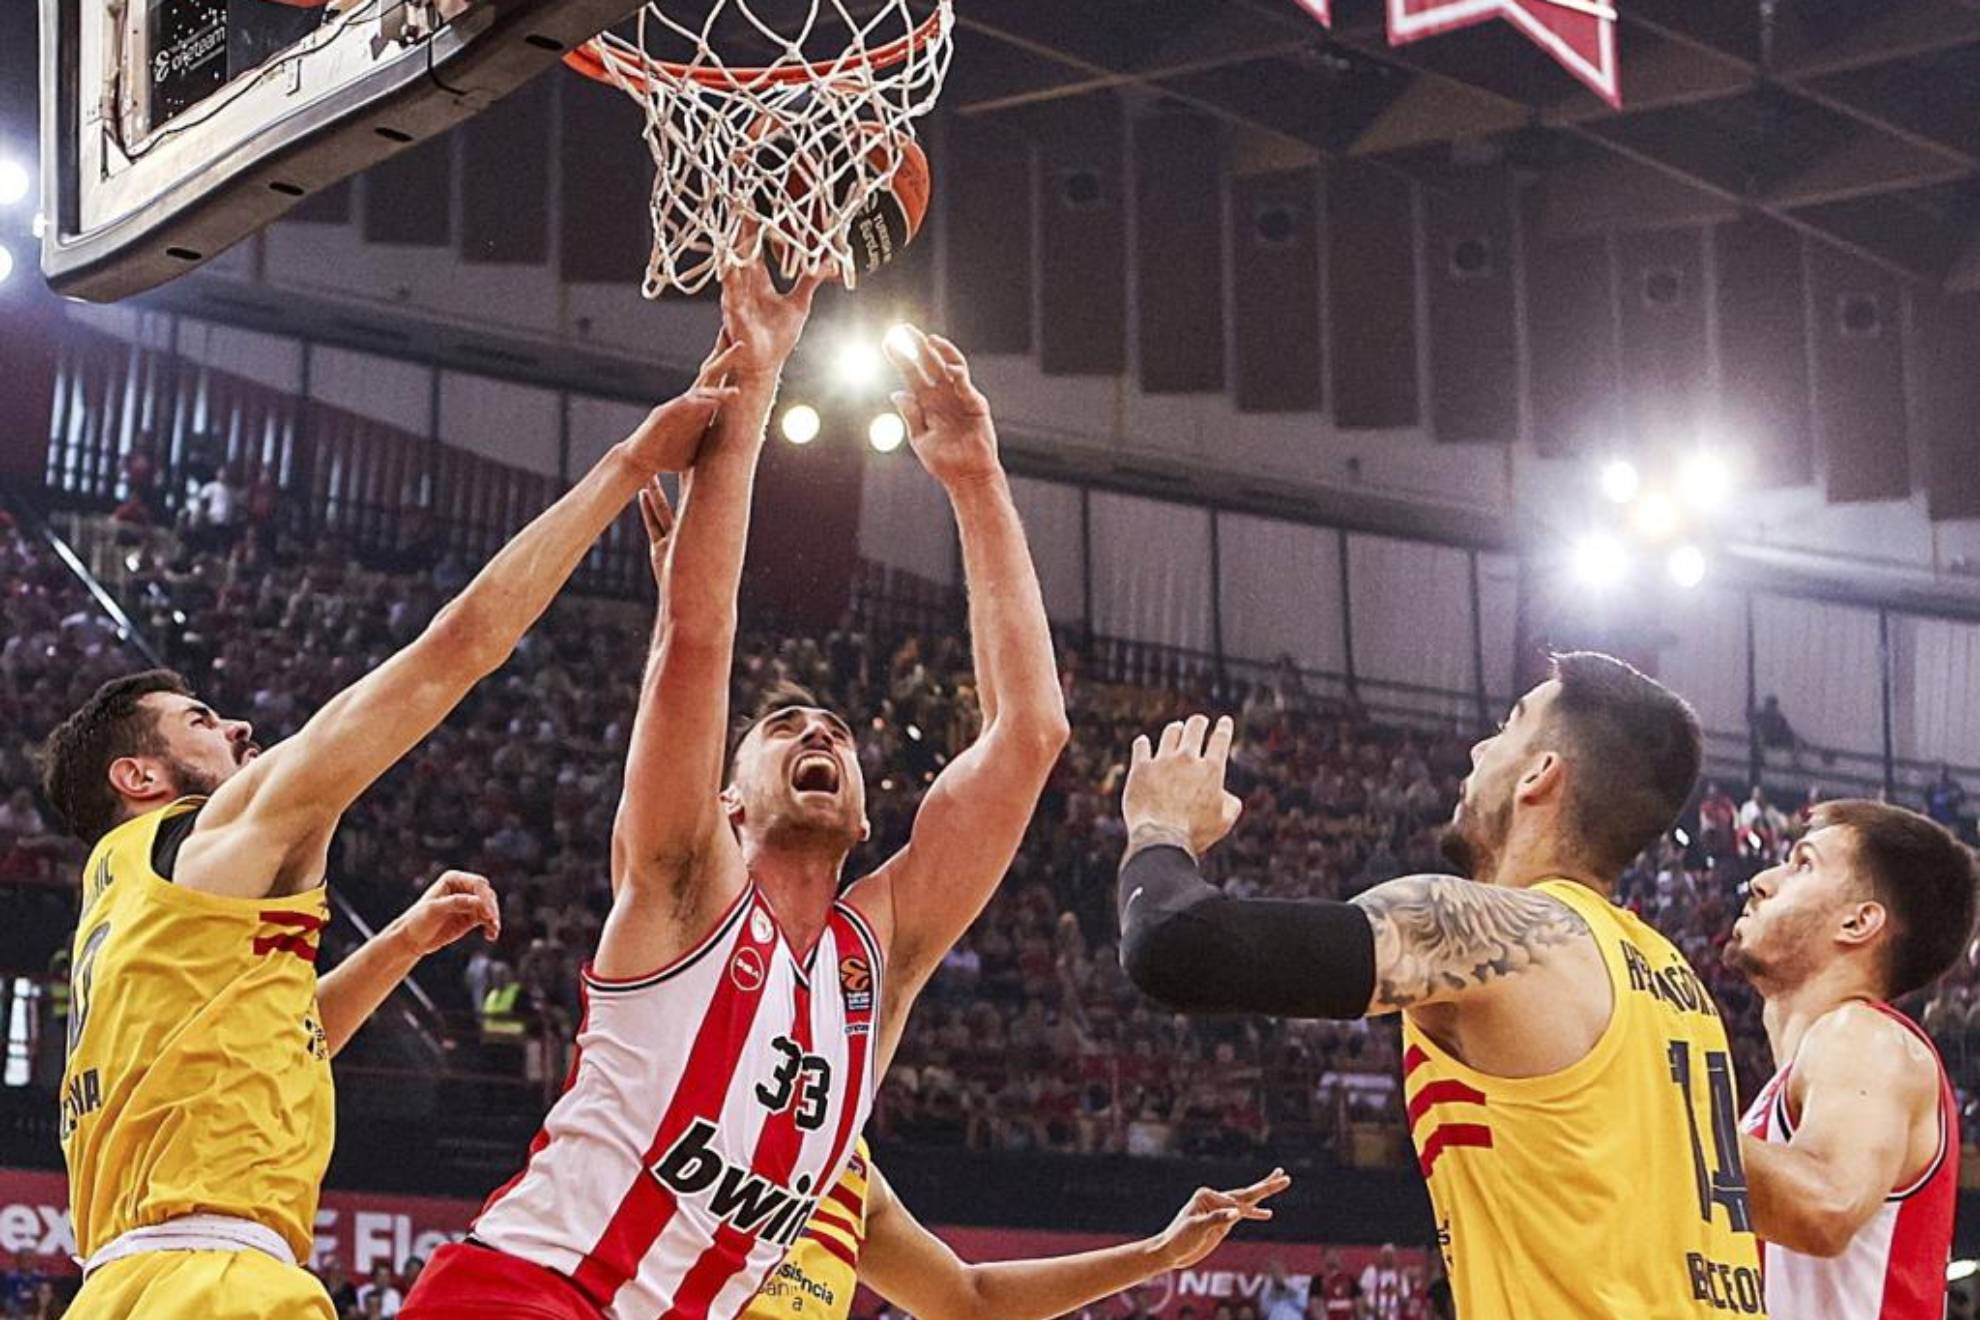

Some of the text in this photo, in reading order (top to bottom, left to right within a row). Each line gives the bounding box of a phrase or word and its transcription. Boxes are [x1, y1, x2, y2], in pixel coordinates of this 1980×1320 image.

[754, 1034, 832, 1131] 33
[1668, 1040, 1754, 1232] 14
[1178, 1270, 1268, 1297] NEV
